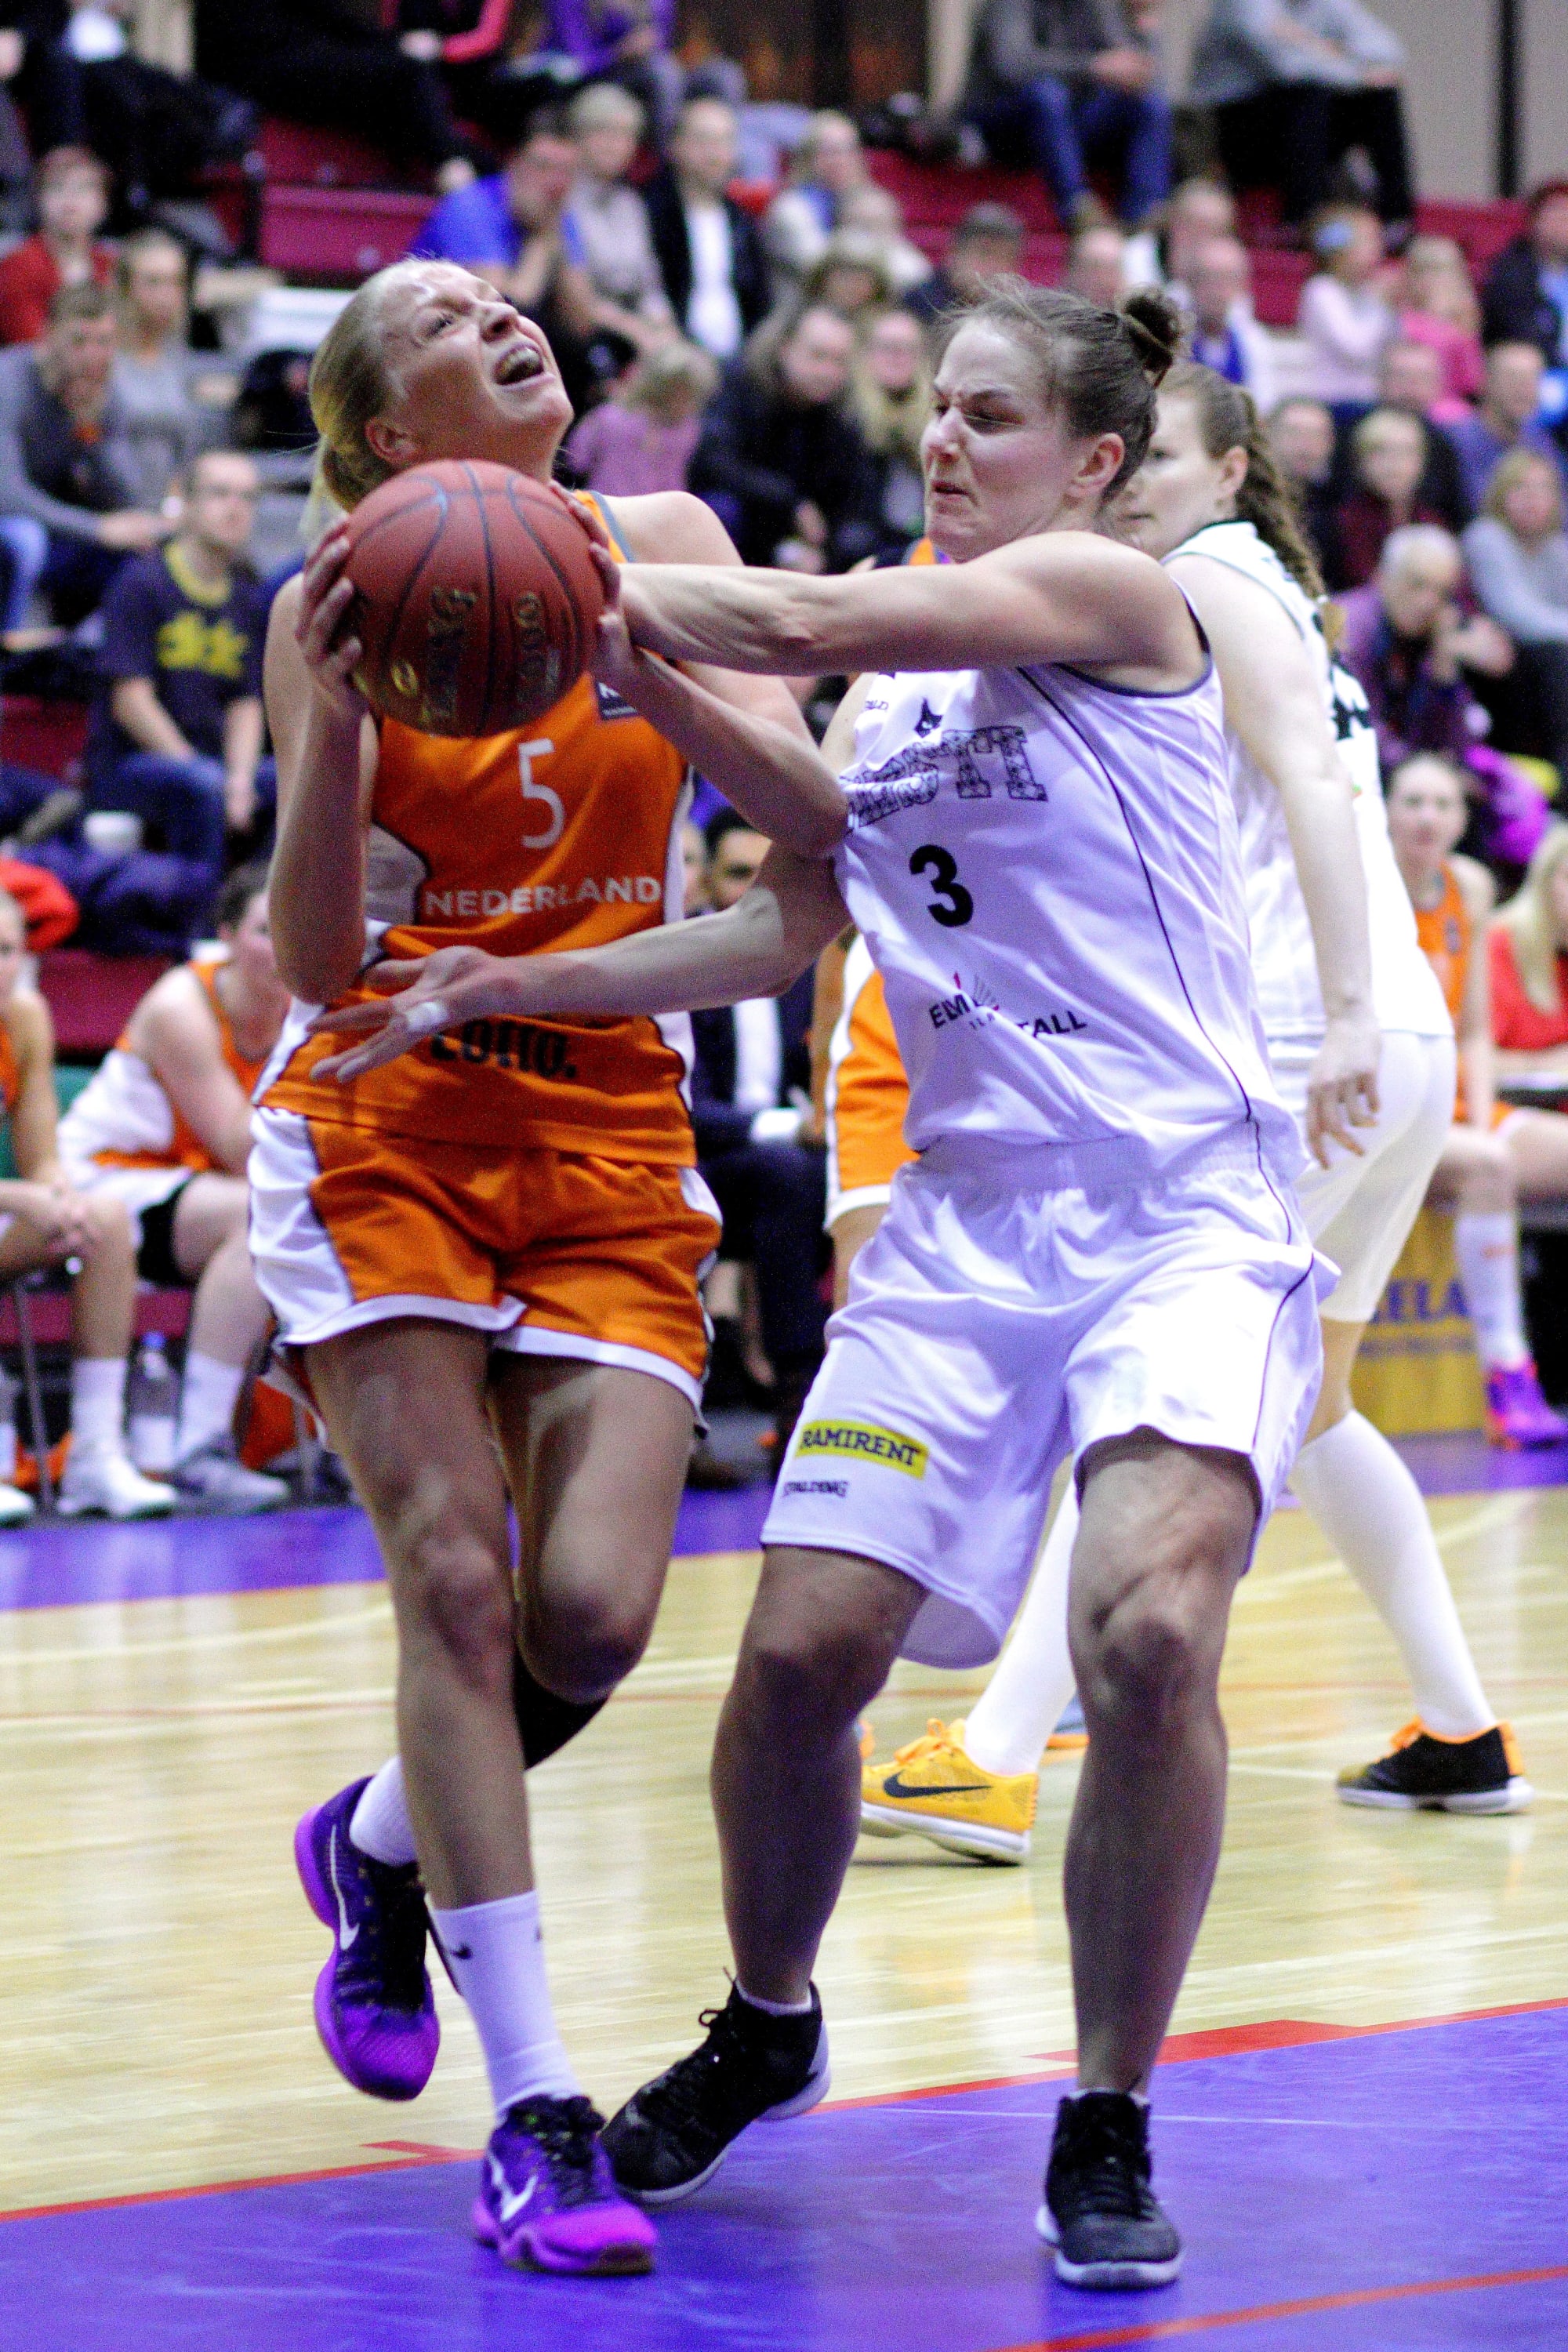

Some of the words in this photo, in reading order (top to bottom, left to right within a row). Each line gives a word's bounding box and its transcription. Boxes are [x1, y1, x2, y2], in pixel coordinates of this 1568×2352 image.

[517, 738, 567, 850] 5
[424, 877, 662, 917] NEDERLAND
[909, 844, 975, 928] 3
[800, 1428, 921, 1467] RAMIRENT
